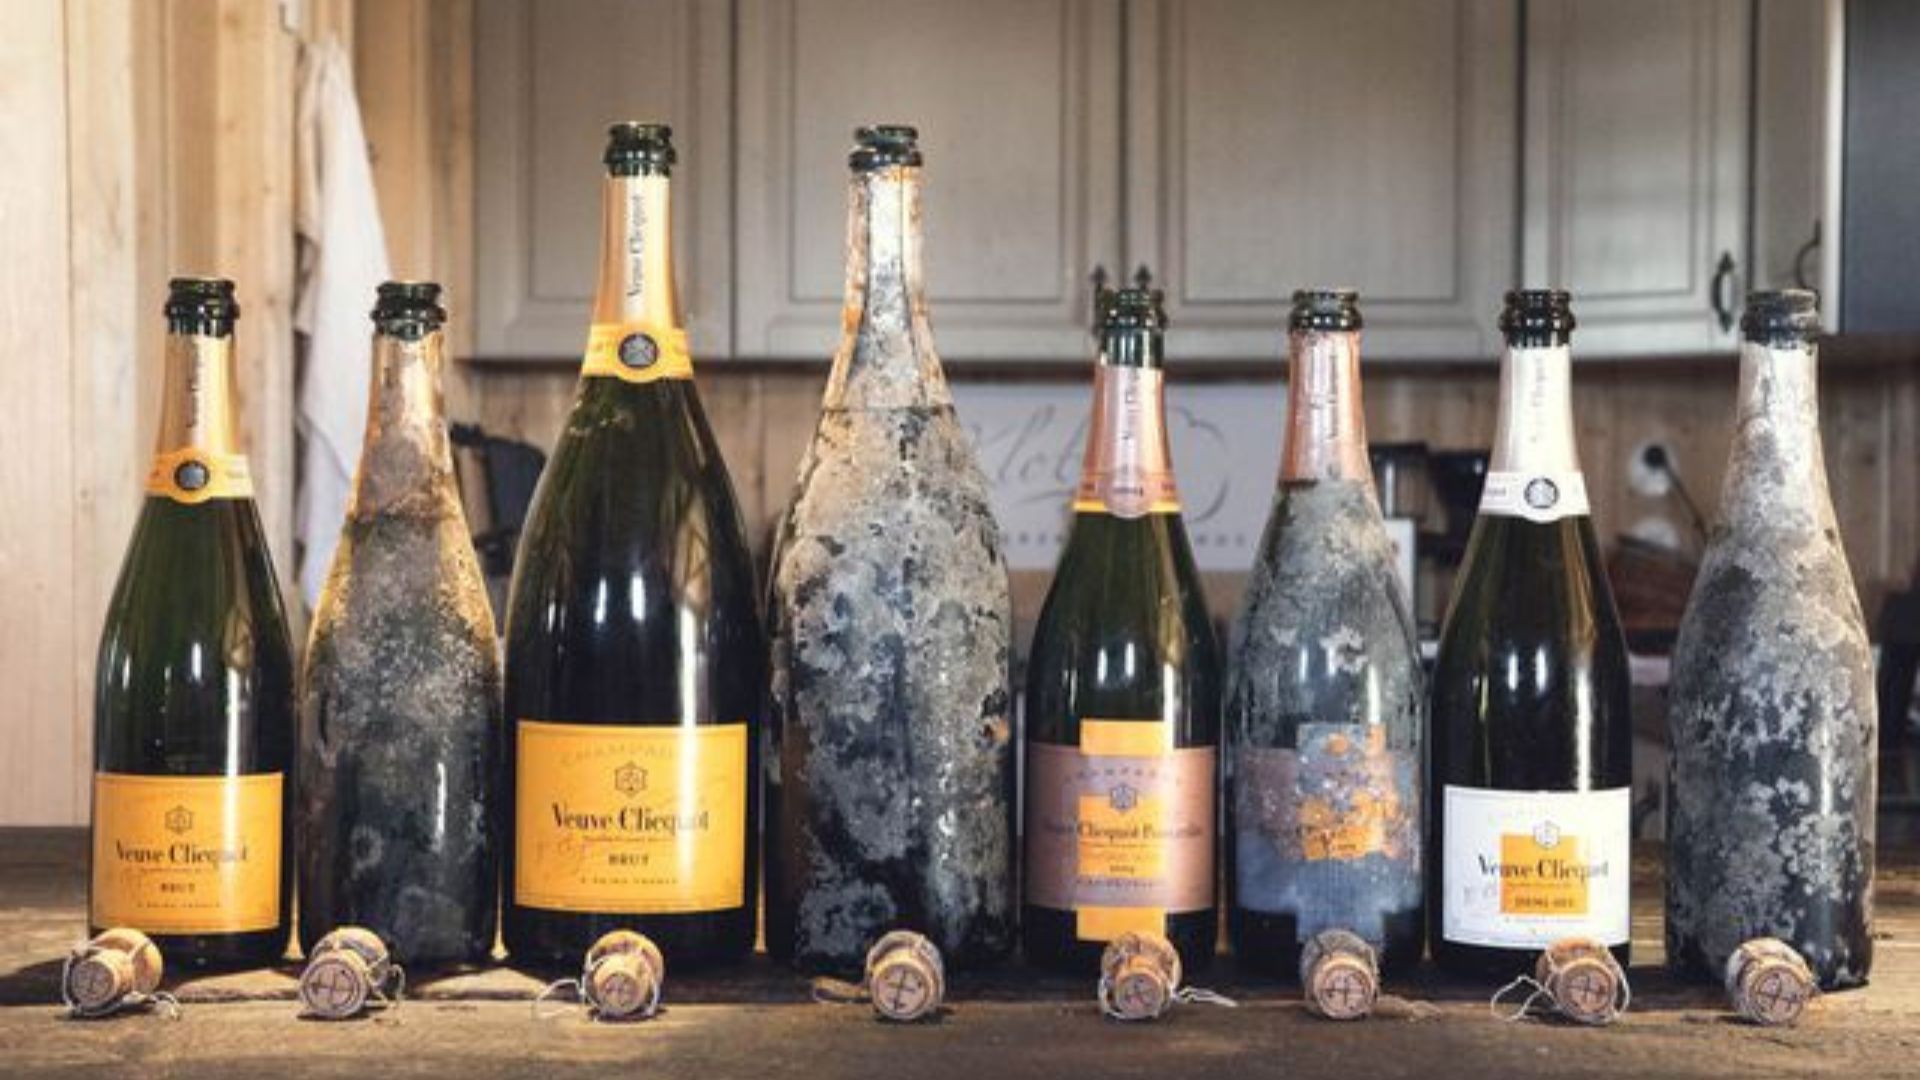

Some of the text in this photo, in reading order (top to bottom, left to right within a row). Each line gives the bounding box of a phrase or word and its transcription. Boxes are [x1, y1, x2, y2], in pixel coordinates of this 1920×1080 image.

[626, 195, 646, 297] Veuve Clicquot
[552, 803, 709, 836] Veuve Clicquot
[116, 839, 248, 870] Veuve Clicquot
[608, 853, 649, 866] BRUT
[1478, 853, 1609, 884] Veuve Clicquot
[161, 883, 195, 893] BRUT
